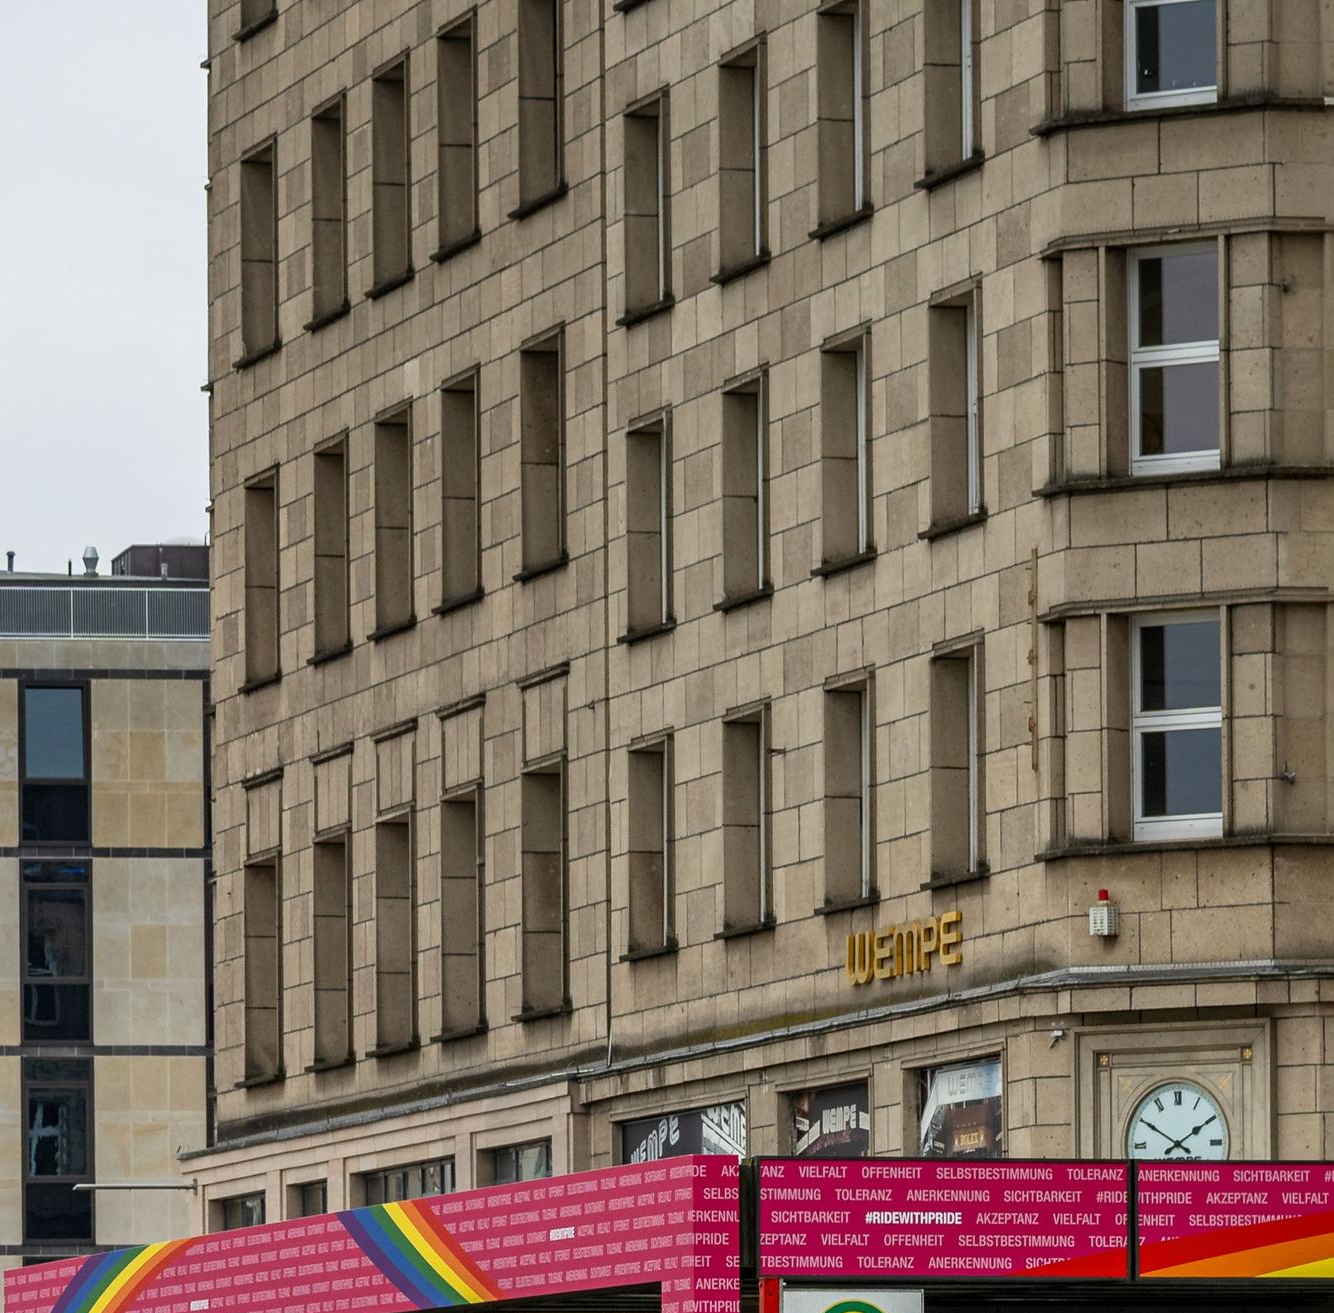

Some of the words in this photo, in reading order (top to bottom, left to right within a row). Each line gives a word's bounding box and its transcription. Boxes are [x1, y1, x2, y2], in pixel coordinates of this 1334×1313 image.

[845, 911, 962, 986] WEMPE
[822, 1104, 857, 1134] WEMPE
[799, 1166, 848, 1178] VIELFALT
[861, 1167, 923, 1179] OFFENHEIT
[937, 1168, 1053, 1180] SELBSTBESTIMMUNG
[1067, 1168, 1123, 1181] TOLERANZ
[1139, 1170, 1219, 1182] ANERKENNUNG
[1233, 1170, 1311, 1182] SICHTBARKEIT
[835, 1189, 892, 1201] TOLERANZ
[907, 1190, 990, 1202] ANERKENNUNG
[1003, 1190, 1083, 1203] SICHTBARKEIT
[1205, 1192, 1267, 1205] AKZEPTANZ
[1281, 1193, 1329, 1205] VIELFALT
[771, 1211, 851, 1224] SICHTBARKEIT
[865, 1211, 963, 1225] #RIDEWITHPRIDE
[976, 1212, 1039, 1225] AKZEPTANZ
[1053, 1214, 1101, 1225] VIELFALT
[821, 1234, 869, 1246] VIELFALT
[883, 1234, 945, 1247] OFFENHEIT
[959, 1234, 1075, 1248] SELBSTBESTIMMUNG
[857, 1256, 915, 1269] TOLERANZ
[929, 1257, 1013, 1270] ANERKENNUNG
